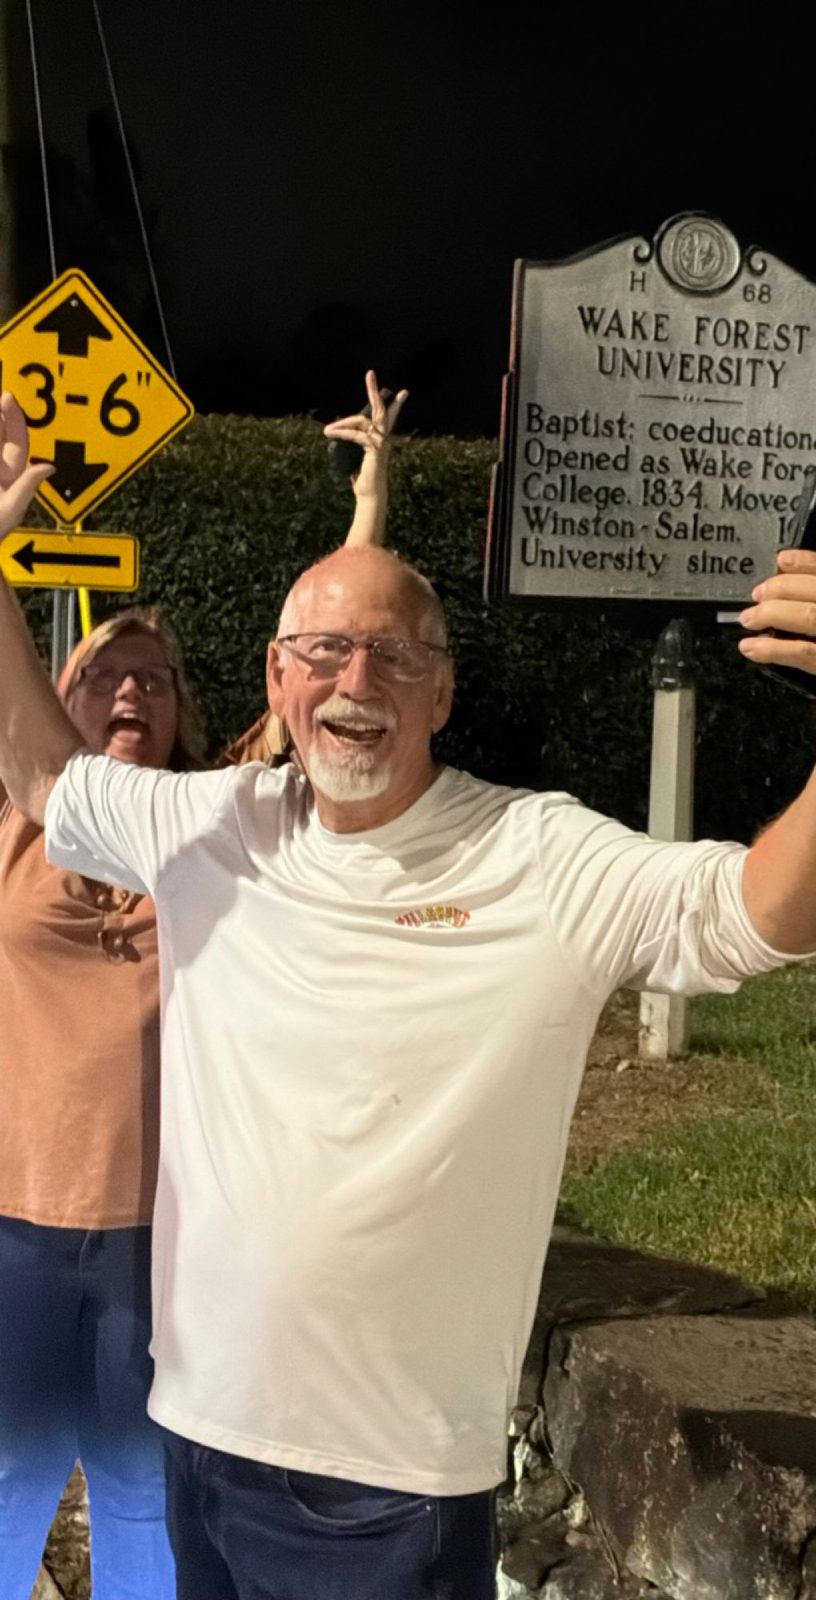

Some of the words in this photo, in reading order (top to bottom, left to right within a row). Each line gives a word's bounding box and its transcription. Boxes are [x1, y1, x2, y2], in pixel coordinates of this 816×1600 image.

[630, 271, 646, 292] H
[743, 284, 772, 304] 68
[578, 305, 670, 343] WAKE
[694, 316, 810, 354] FOREST
[598, 346, 787, 388] UNIVERSITY
[648, 418, 816, 450] coeducation
[525, 438, 630, 474] Opened
[640, 455, 670, 474] as
[680, 448, 753, 478] Wake
[521, 537, 667, 577] University
[687, 549, 754, 574] since
